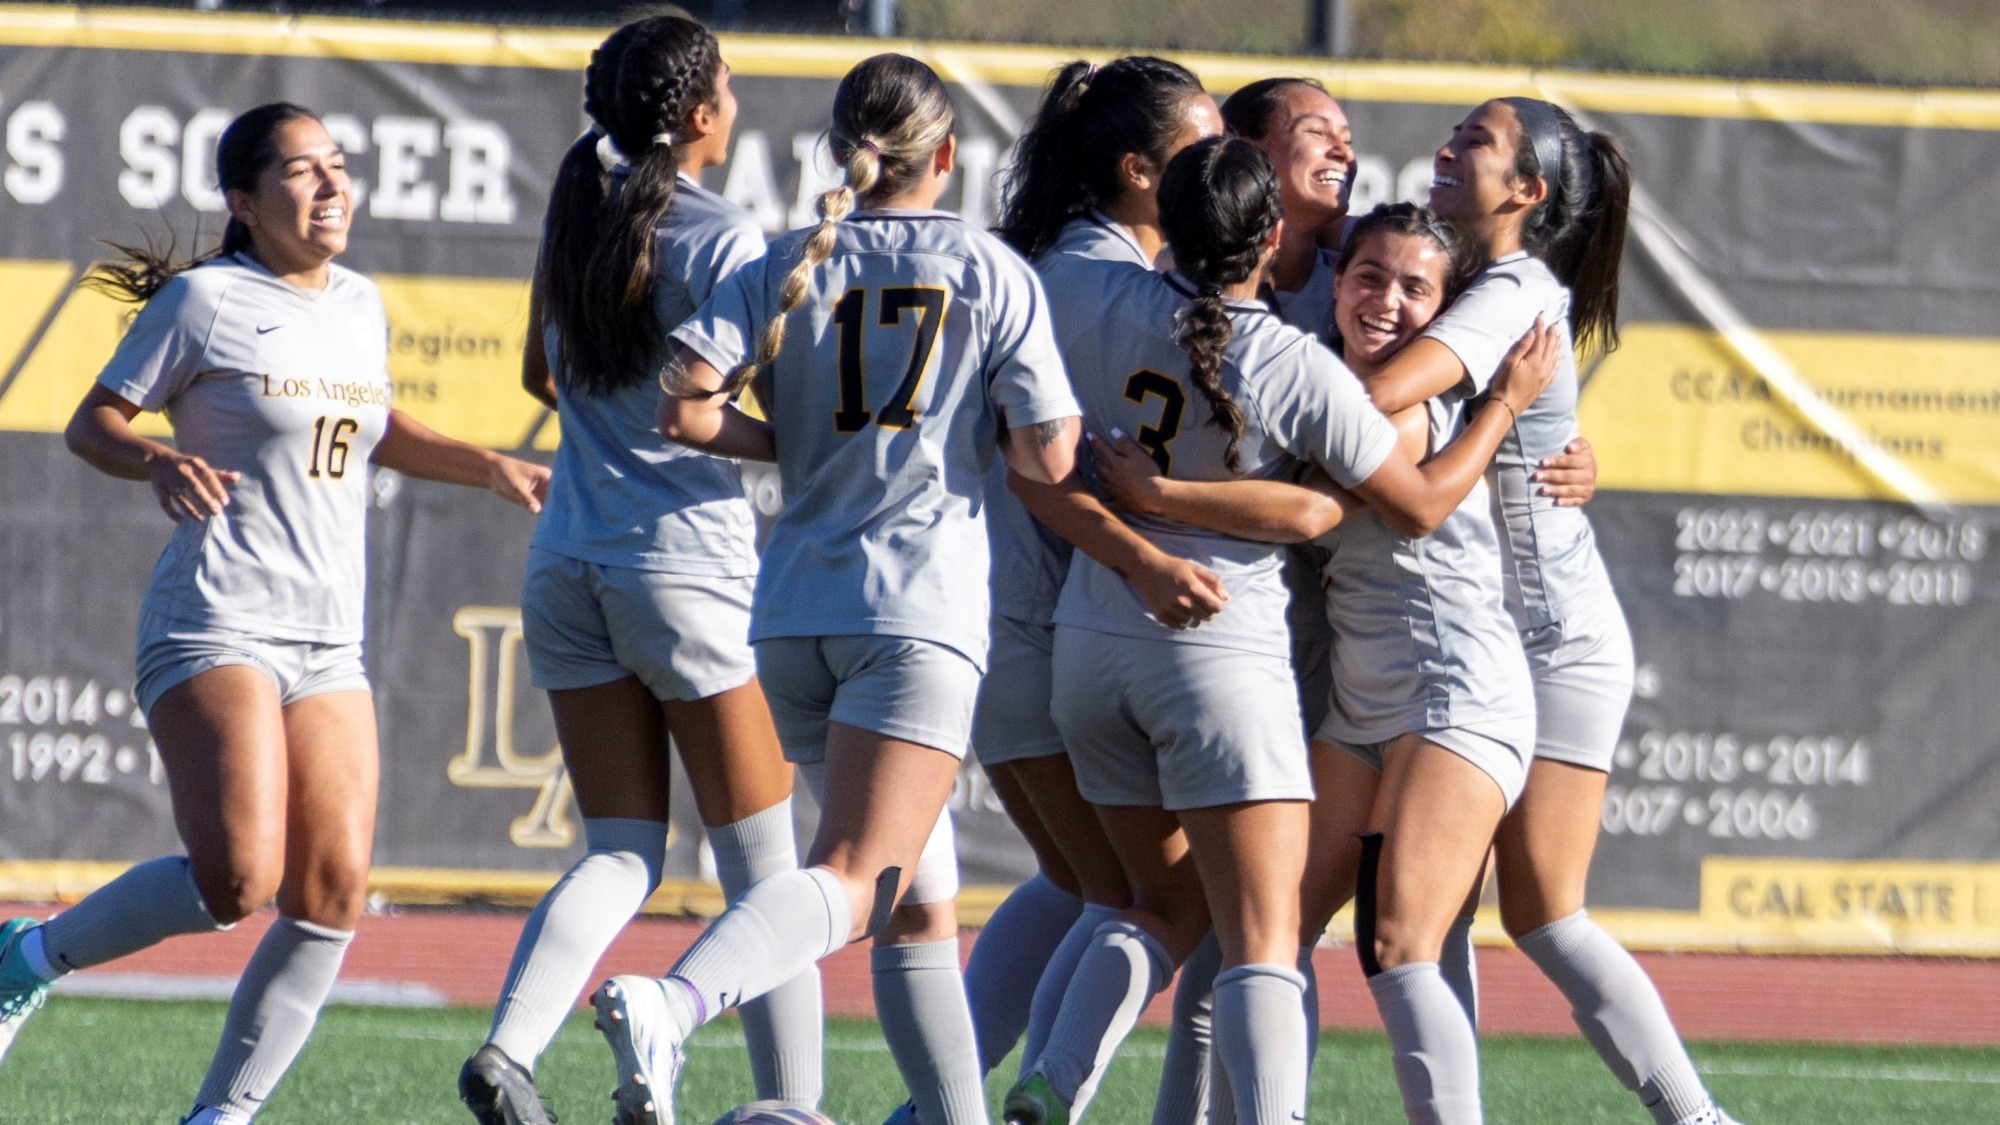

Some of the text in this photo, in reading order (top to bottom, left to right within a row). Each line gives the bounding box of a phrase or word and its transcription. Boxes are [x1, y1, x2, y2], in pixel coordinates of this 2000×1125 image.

[117, 103, 516, 224] SOER
[386, 320, 503, 366] egion
[834, 285, 946, 433] 17
[260, 373, 311, 398] Los
[308, 414, 359, 479] 16
[1122, 368, 1186, 478] 3
[1766, 736, 1869, 786] 2014
[1600, 785, 1683, 836] 007
[1727, 874, 1815, 920] CAL
[1831, 878, 1954, 925] STATE
